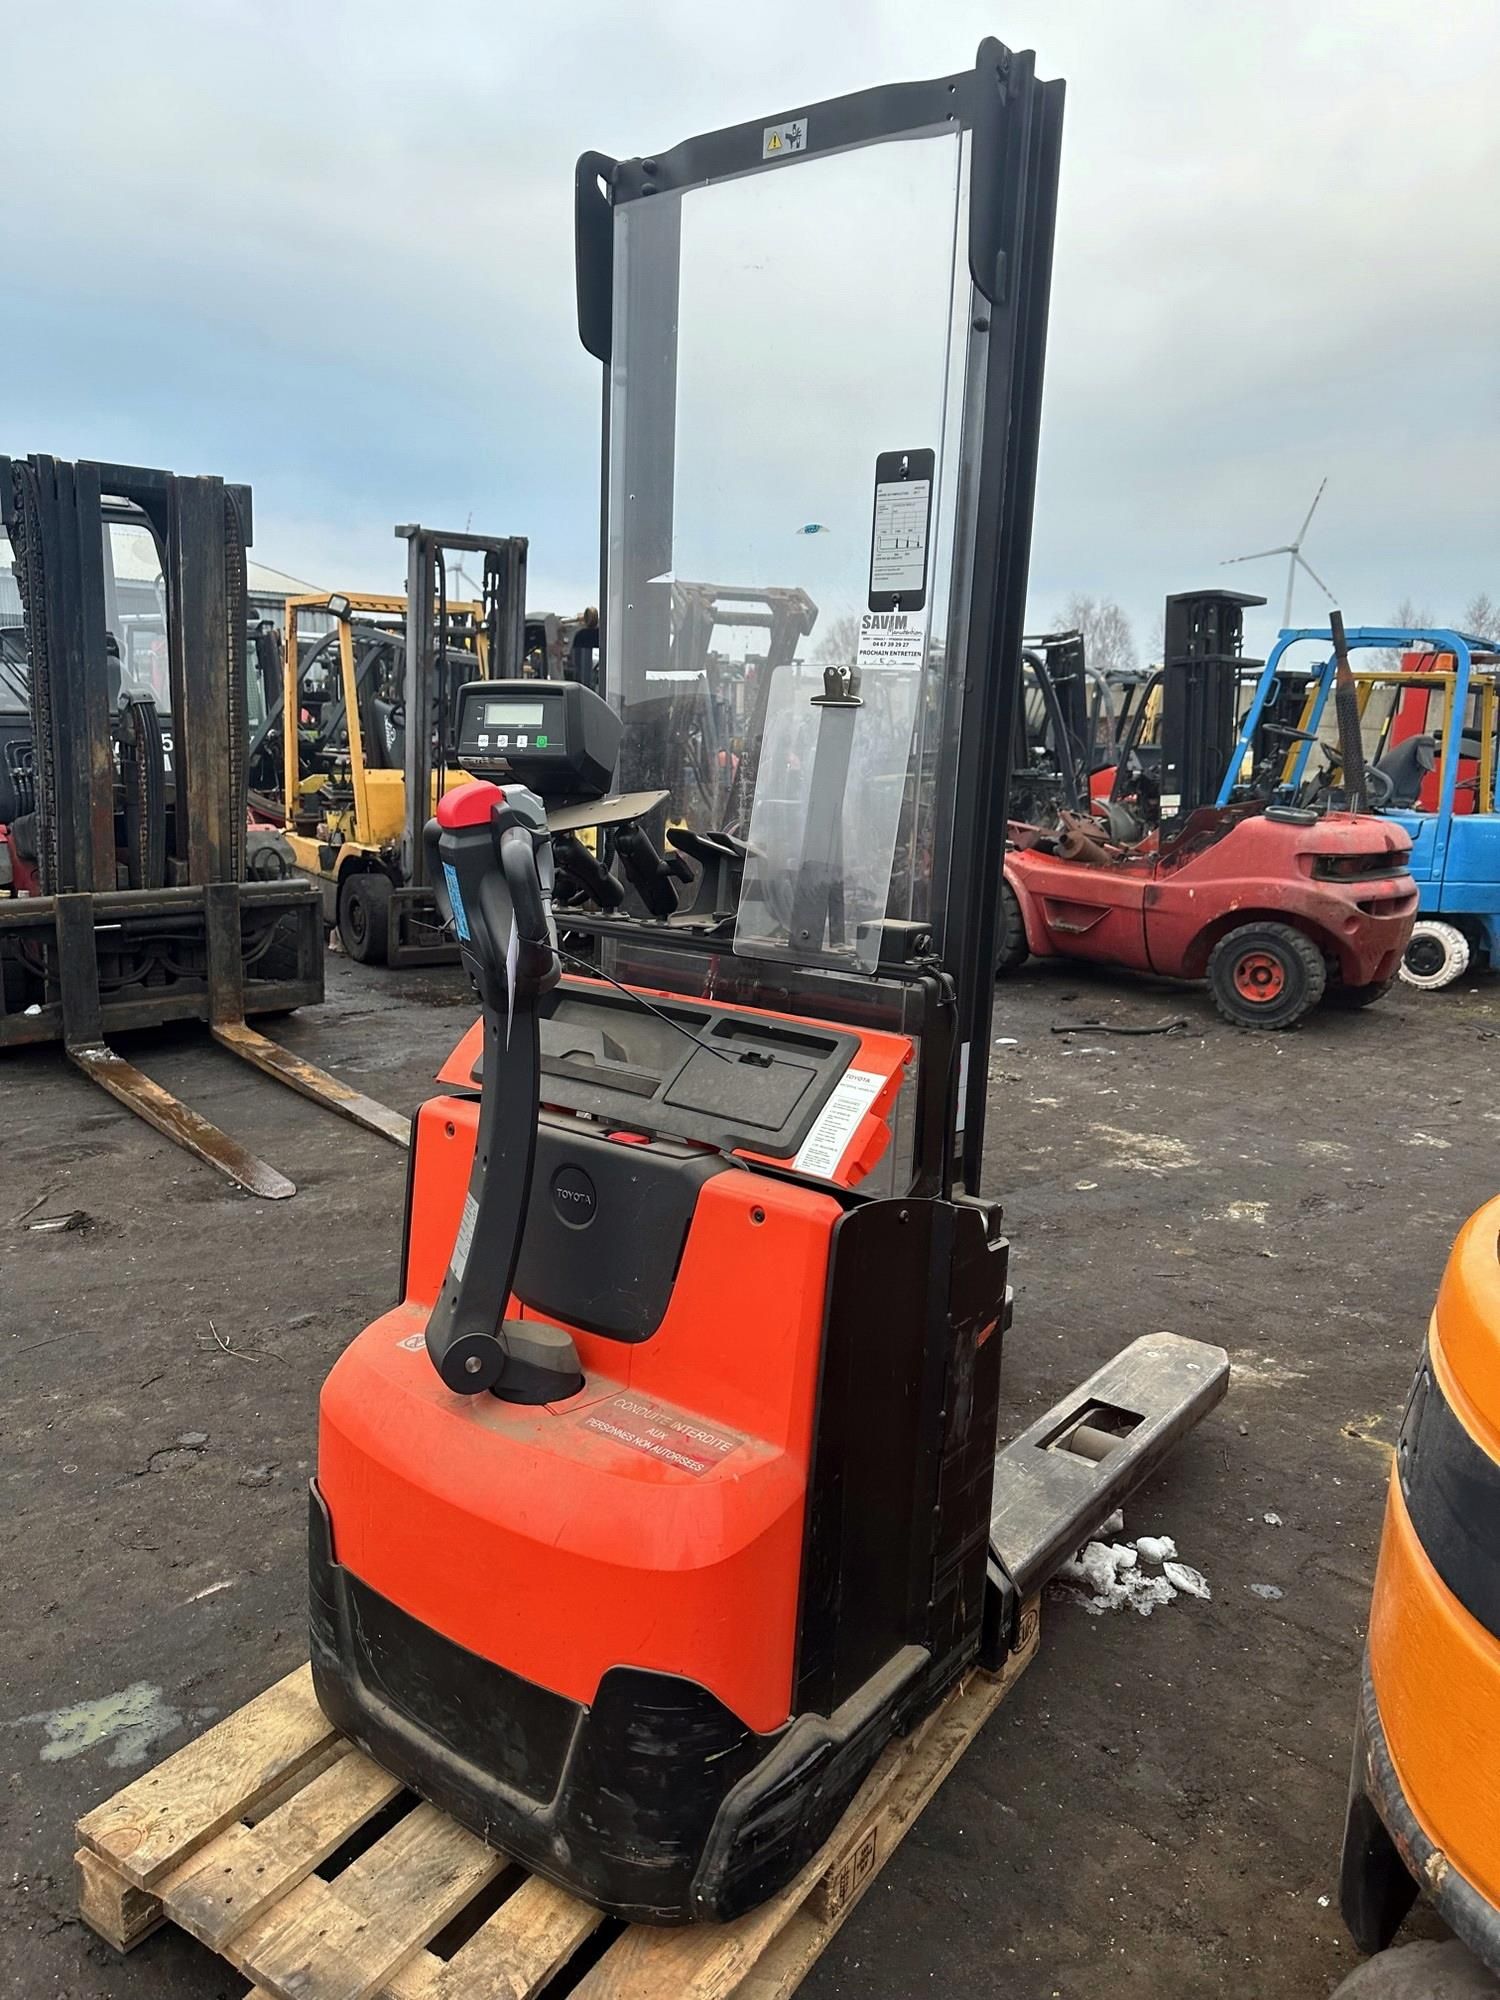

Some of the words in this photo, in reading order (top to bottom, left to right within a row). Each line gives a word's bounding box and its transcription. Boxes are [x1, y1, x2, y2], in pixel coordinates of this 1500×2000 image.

[862, 614, 908, 630] SAVIM
[846, 1073, 871, 1083] TOYOTA
[556, 1188, 591, 1205] TOYOTA
[613, 1398, 673, 1426] CONDUITE
[670, 1420, 733, 1452] INTERDITE
[645, 1428, 669, 1440] AUX
[585, 1417, 636, 1442] PERSONNES
[632, 1436, 655, 1449] NON
[650, 1444, 705, 1472] AUTORISEES
